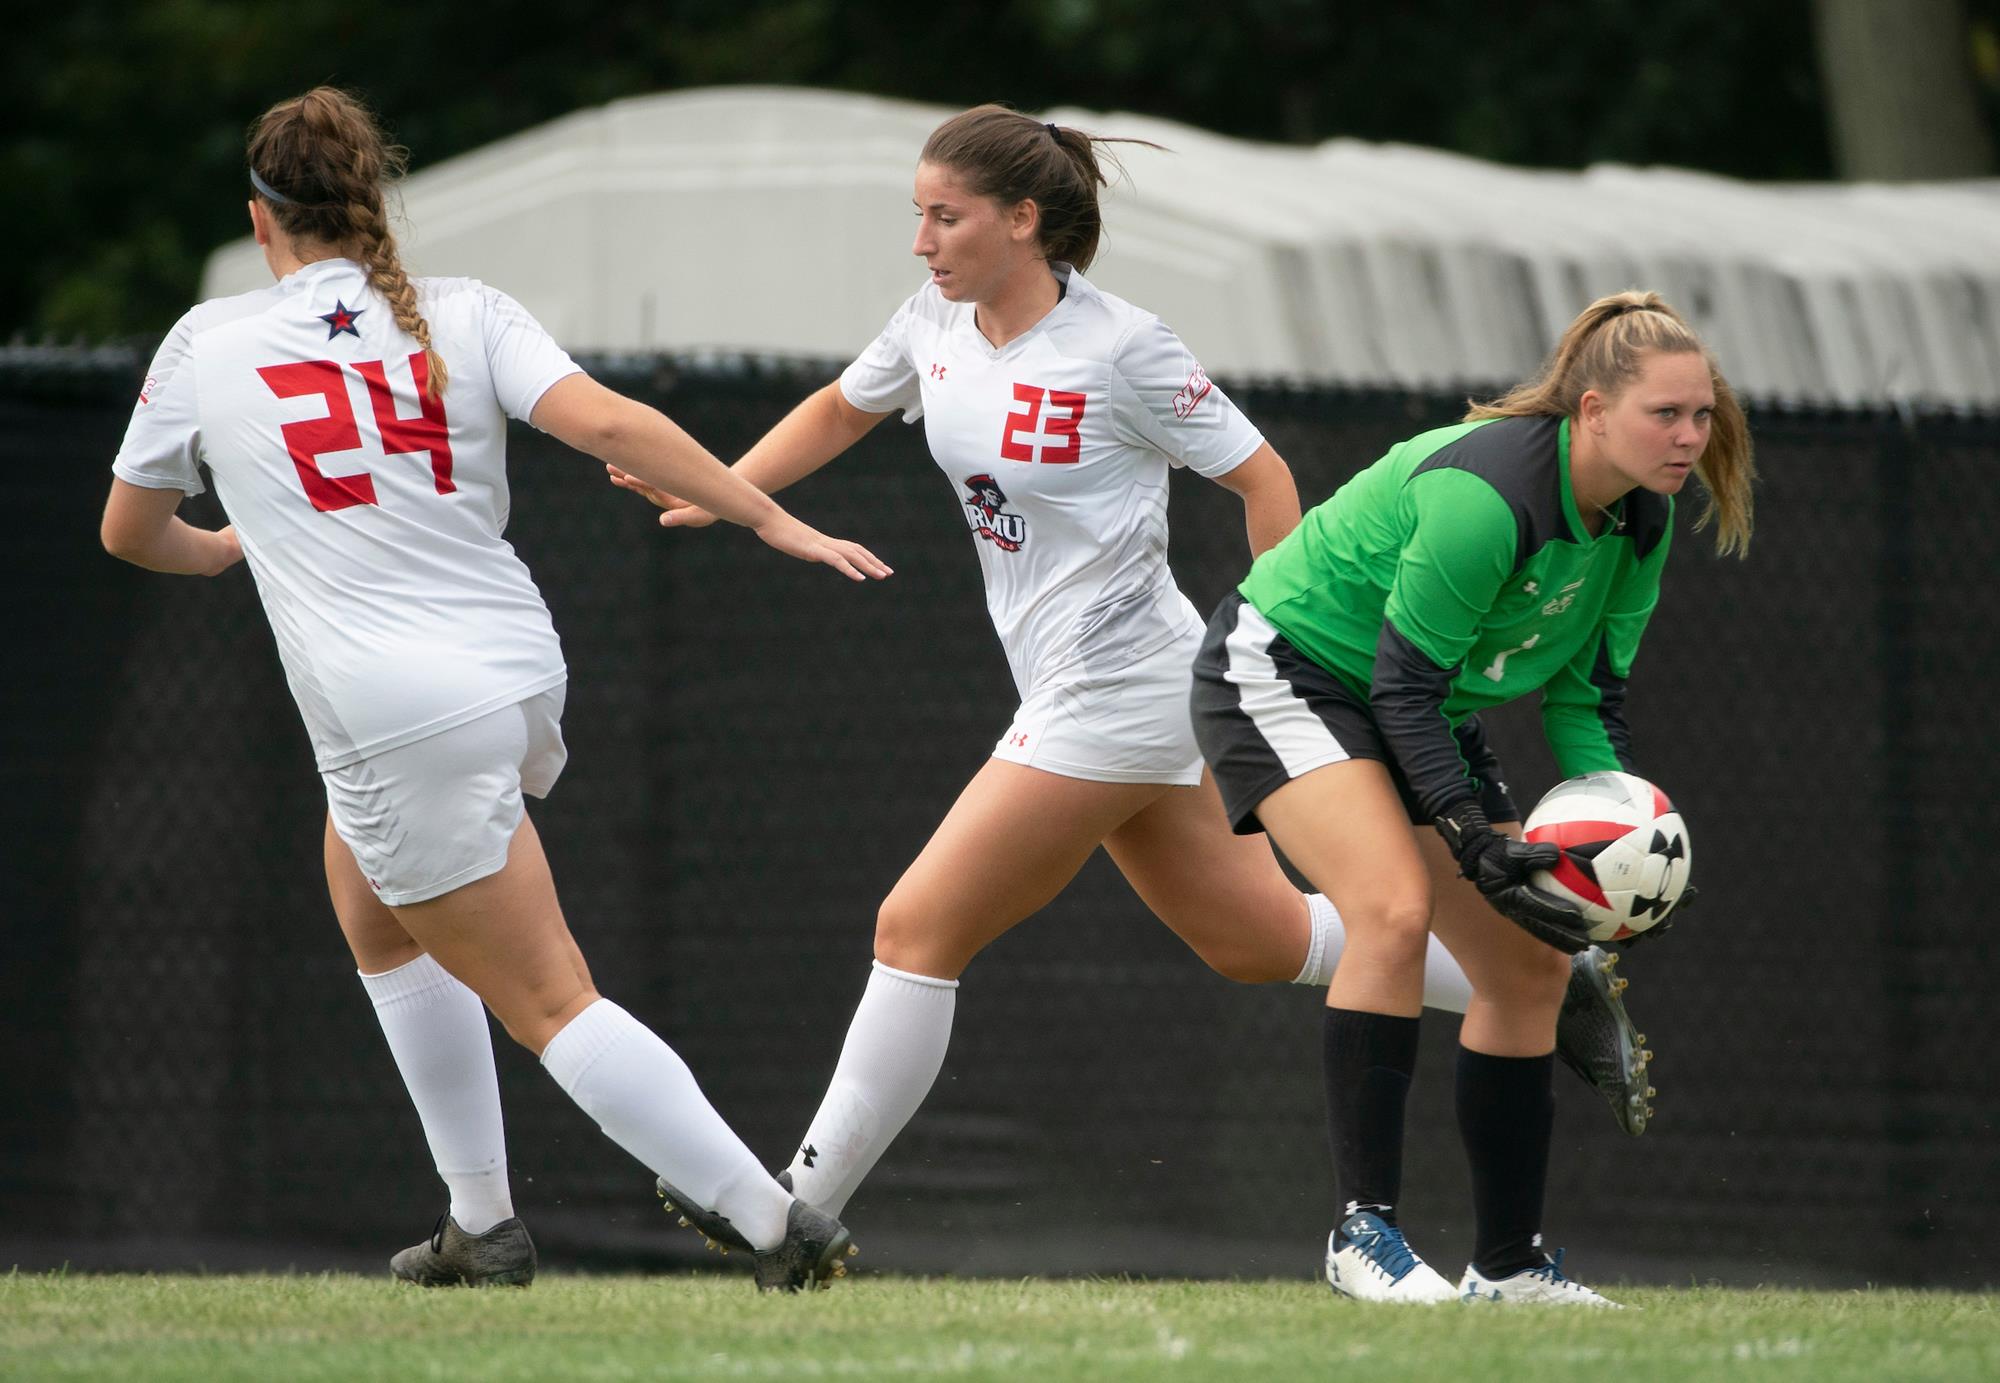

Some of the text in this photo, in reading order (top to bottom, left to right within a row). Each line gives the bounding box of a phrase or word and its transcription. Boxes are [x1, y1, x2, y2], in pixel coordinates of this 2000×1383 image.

[255, 350, 457, 512] 24
[1000, 382, 1087, 464] 23
[966, 503, 1024, 544] RMU
